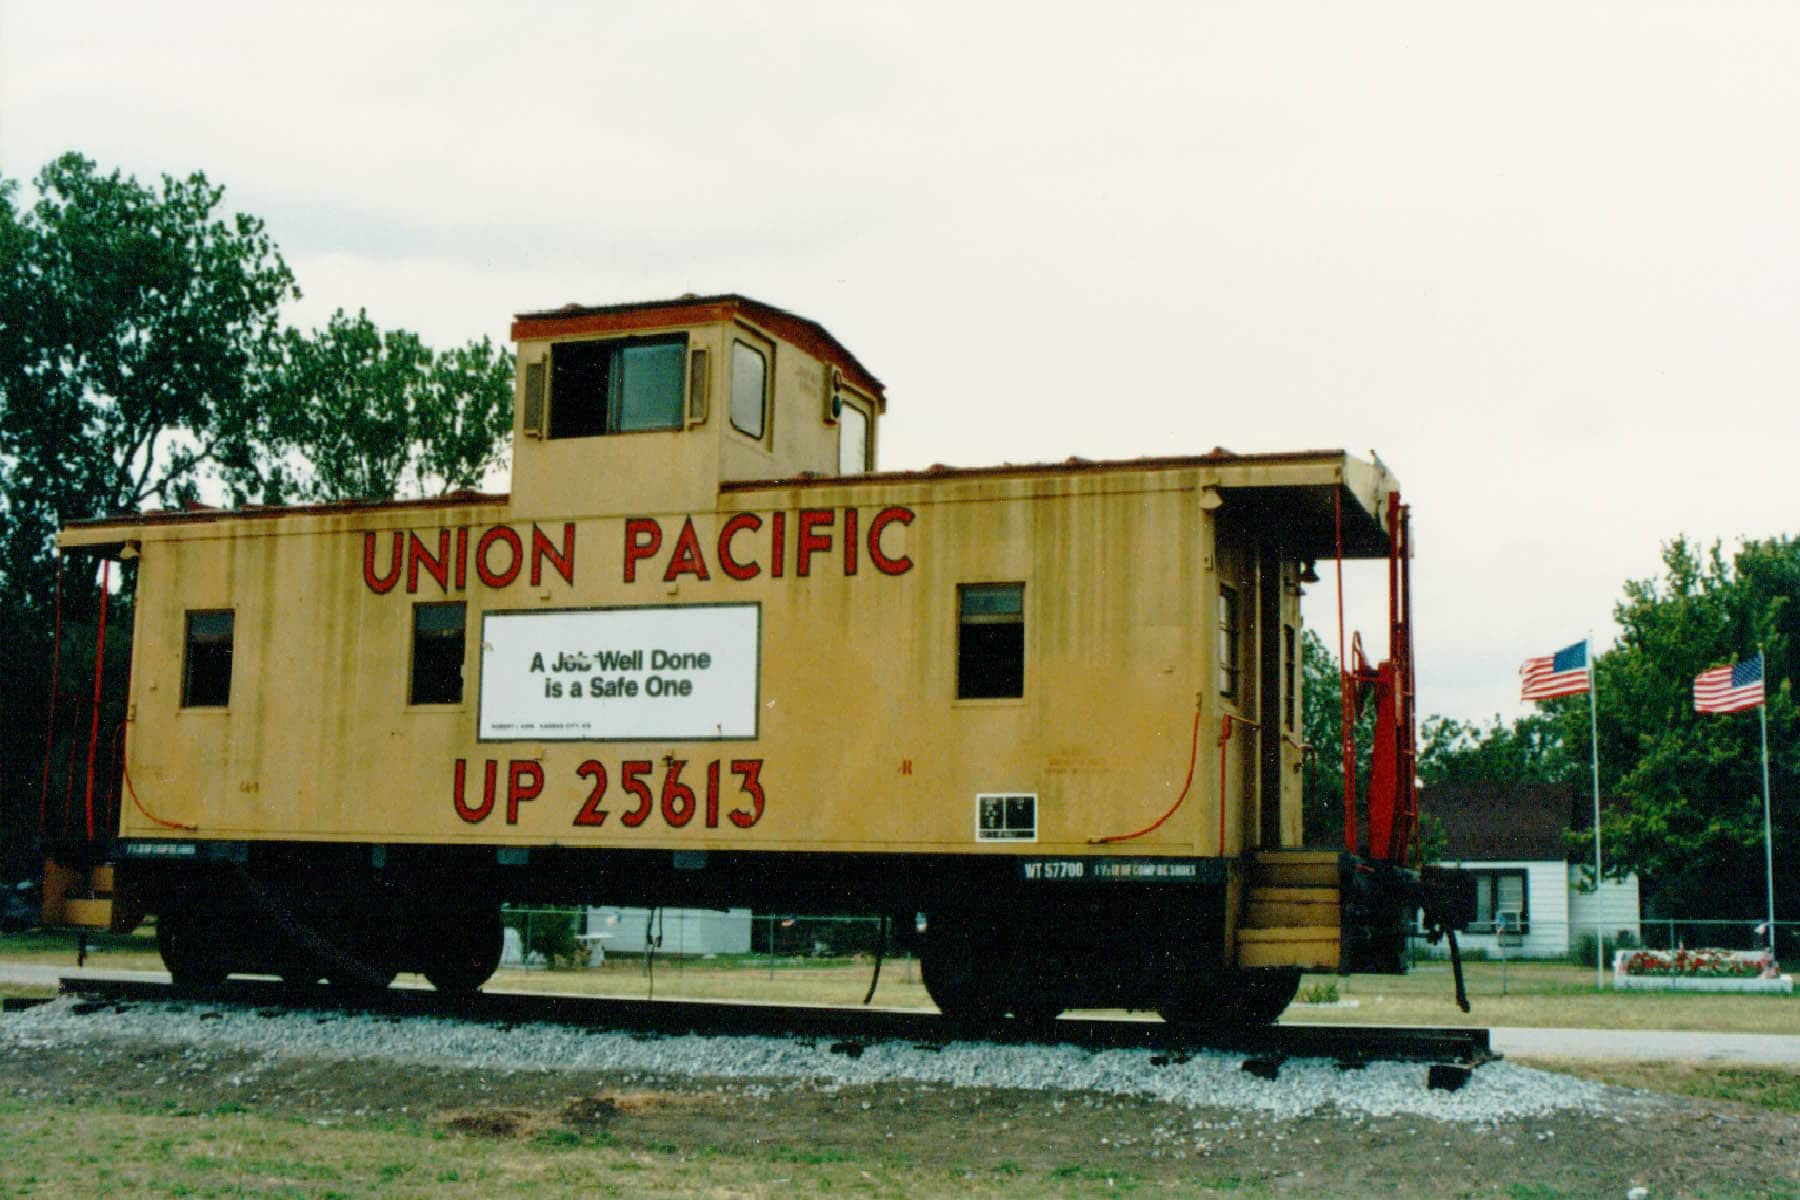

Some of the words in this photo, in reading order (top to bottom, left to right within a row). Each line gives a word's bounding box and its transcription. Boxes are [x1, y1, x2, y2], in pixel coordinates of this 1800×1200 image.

[363, 521, 576, 594] UNION
[623, 506, 916, 584] PACIFIC
[529, 651, 545, 672] A
[597, 650, 643, 671] Well
[651, 649, 711, 671] Done
[544, 677, 563, 698] is
[569, 680, 583, 698] a
[590, 676, 639, 698] Safe
[645, 676, 692, 698] One
[453, 758, 545, 825] UP
[572, 758, 766, 829] 25613
[1024, 863, 1042, 878] WT
[1044, 862, 1084, 878] 57700
